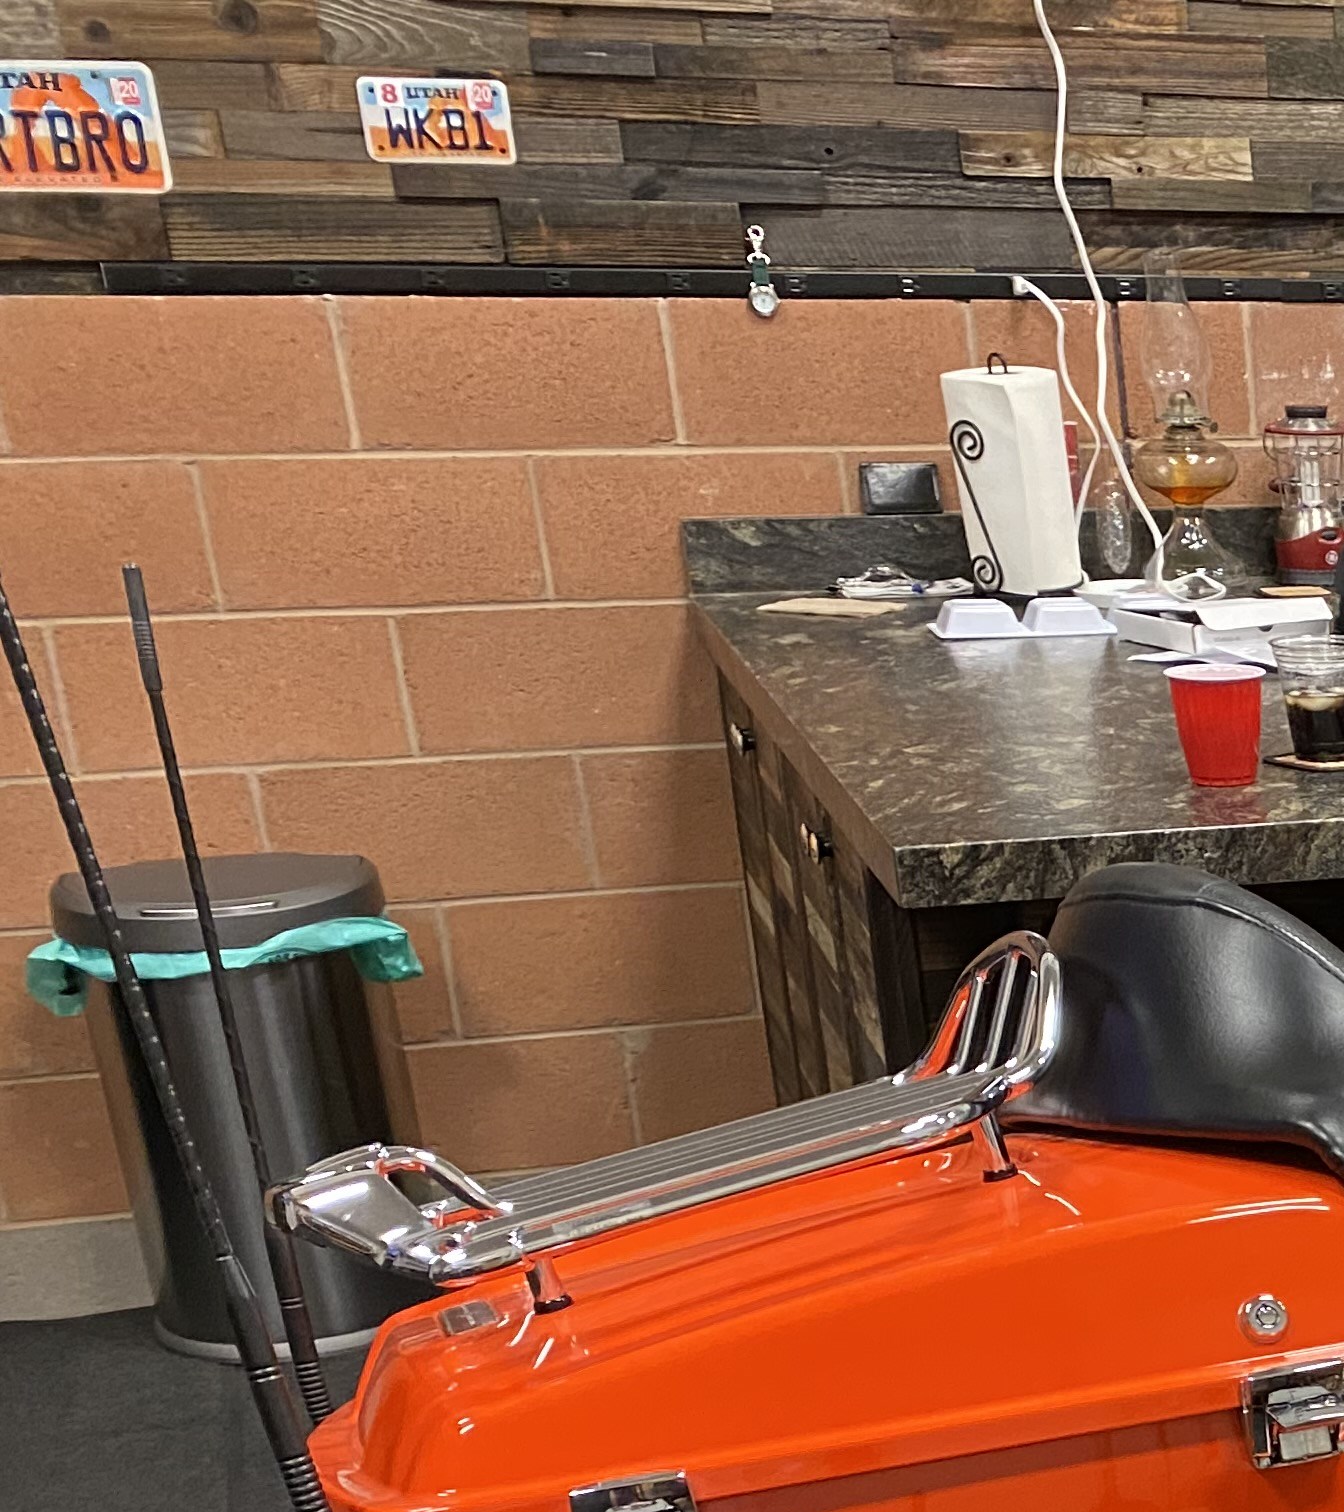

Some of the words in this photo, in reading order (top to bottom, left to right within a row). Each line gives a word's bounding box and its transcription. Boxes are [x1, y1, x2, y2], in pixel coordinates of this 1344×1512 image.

[121, 80, 140, 99] 20
[381, 83, 398, 103] 8
[404, 86, 460, 99] UTAH
[472, 84, 492, 102] 20
